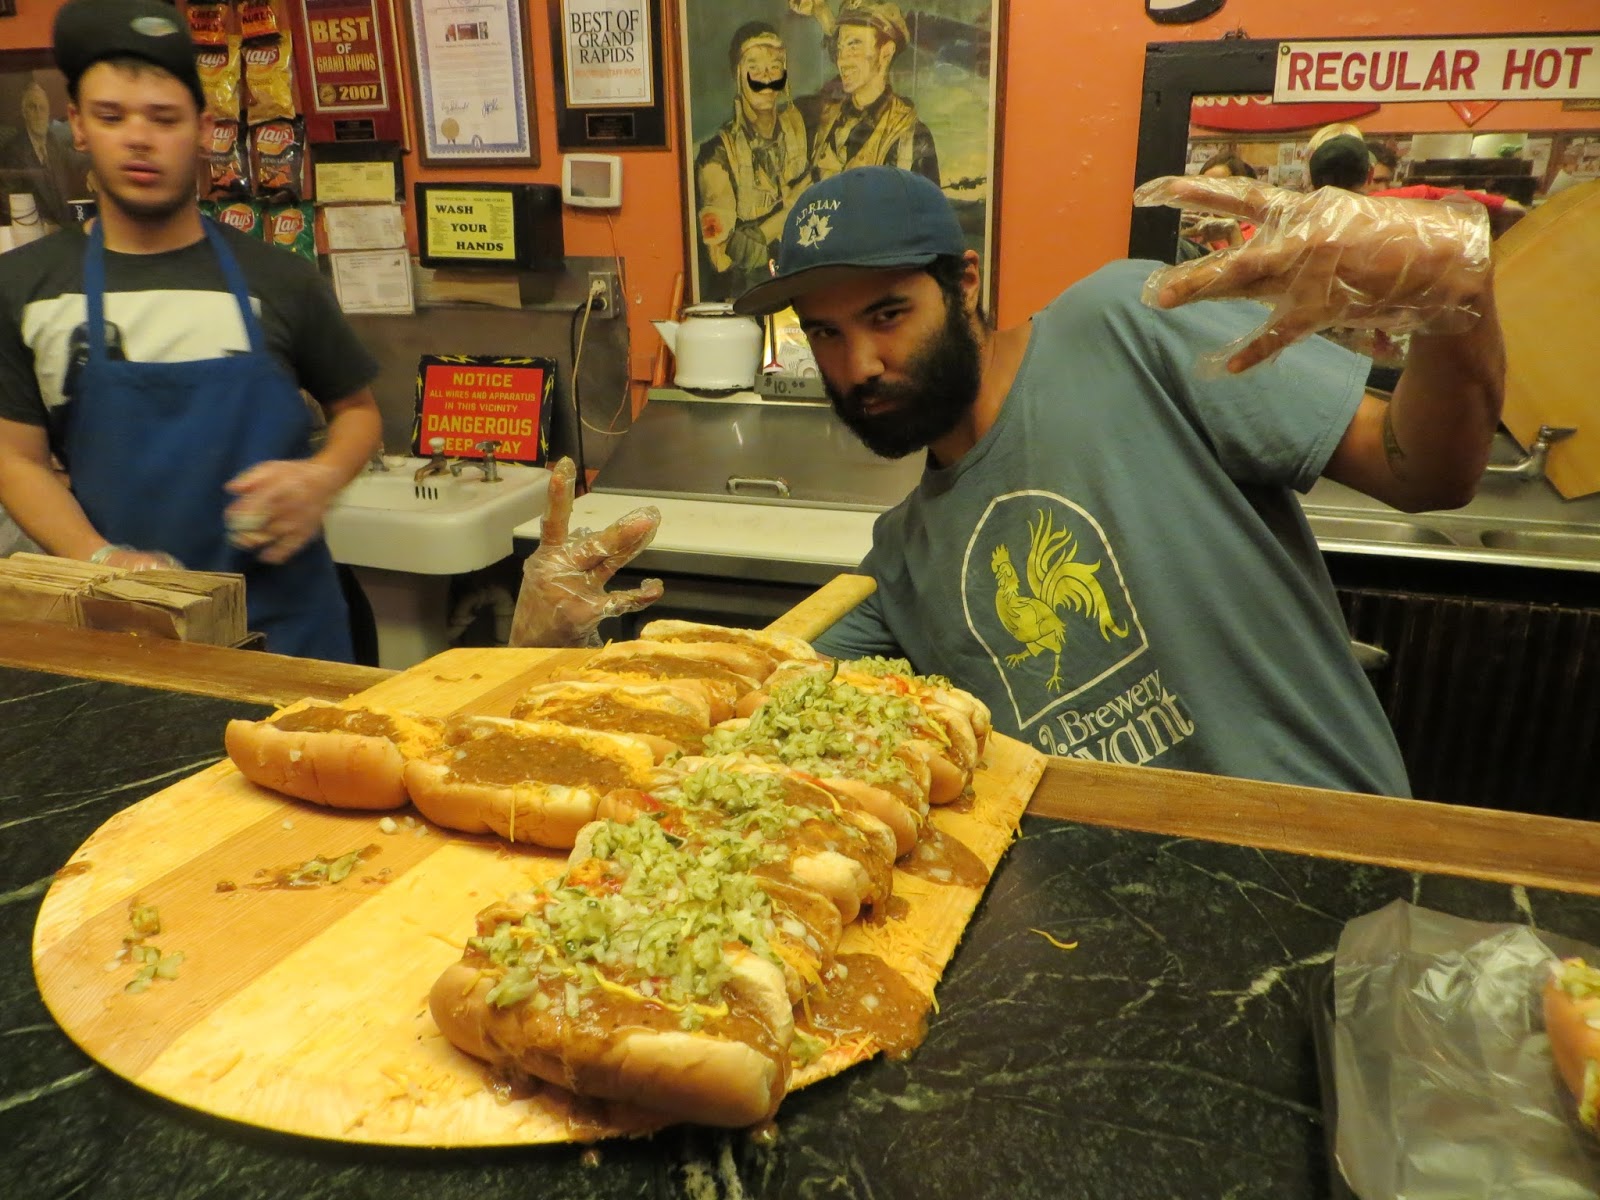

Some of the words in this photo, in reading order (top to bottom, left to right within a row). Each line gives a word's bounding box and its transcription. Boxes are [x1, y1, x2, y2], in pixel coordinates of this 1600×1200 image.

[310, 16, 371, 43] BEST
[570, 11, 613, 34] BEST
[616, 9, 640, 32] OF
[578, 31, 634, 48] GRAND
[336, 43, 352, 54] OF
[579, 47, 635, 64] RAPIDS
[316, 55, 344, 73] GRAND
[345, 53, 376, 72] RAPIDS
[1286, 50, 1482, 92] REGULAR
[1502, 47, 1594, 90] HOT
[338, 85, 378, 101] 2007
[435, 205, 473, 214] WASH
[451, 223, 487, 233] YOUR
[456, 241, 504, 252] HANDS
[453, 372, 513, 387] NOTICE
[429, 390, 443, 398] ALL
[445, 390, 469, 399] WIRES
[471, 391, 487, 400] AND
[488, 392, 536, 401] APPARATUS
[445, 402, 454, 410] IN
[458, 402, 477, 410] THIS
[479, 403, 518, 413] VICINITY
[427, 414, 533, 436] DANGEROUS
[443, 437, 474, 451] EEP
[1056, 669, 1161, 746] Brewery
